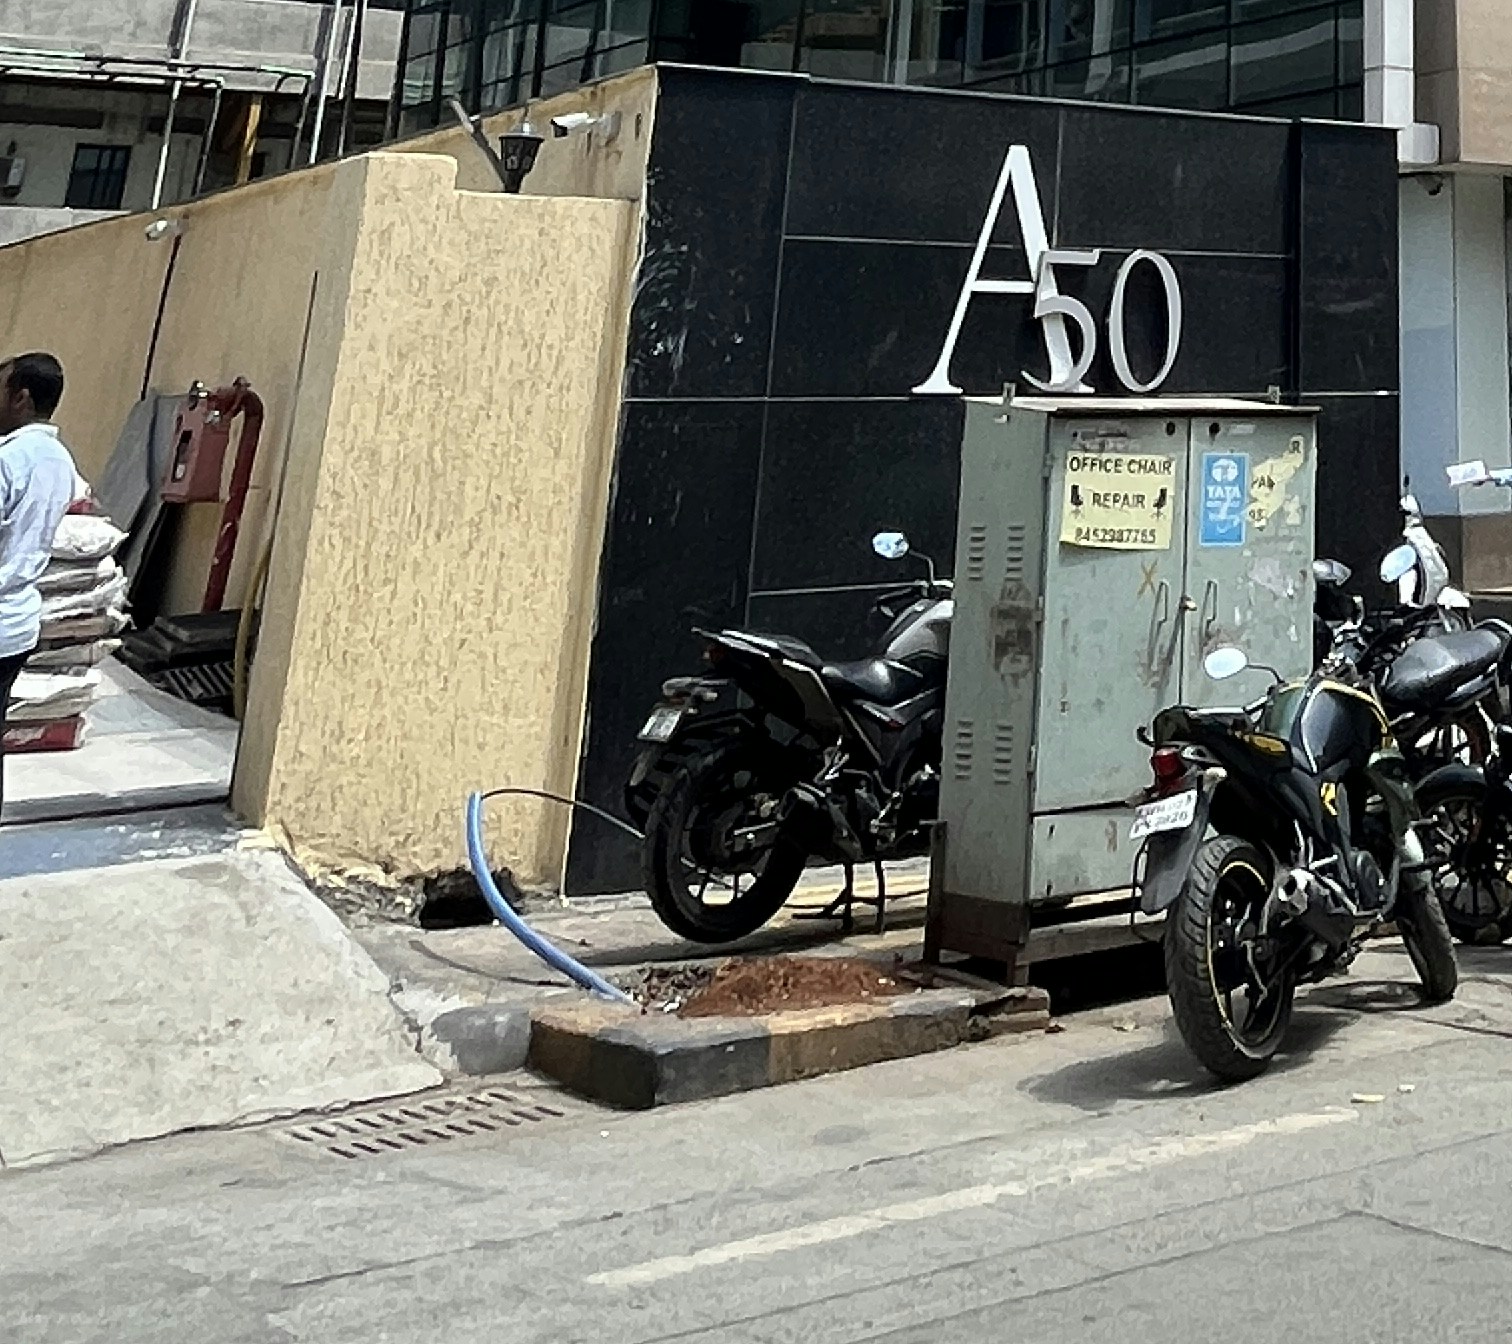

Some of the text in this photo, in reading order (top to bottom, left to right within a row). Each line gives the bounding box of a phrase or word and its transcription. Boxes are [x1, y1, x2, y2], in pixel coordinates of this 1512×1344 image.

[910, 144, 1182, 394] A50
[1069, 456, 1172, 476] OFFICE CHAIR
[1091, 491, 1146, 510] REPAIR
[1206, 484, 1242, 499] TATA
